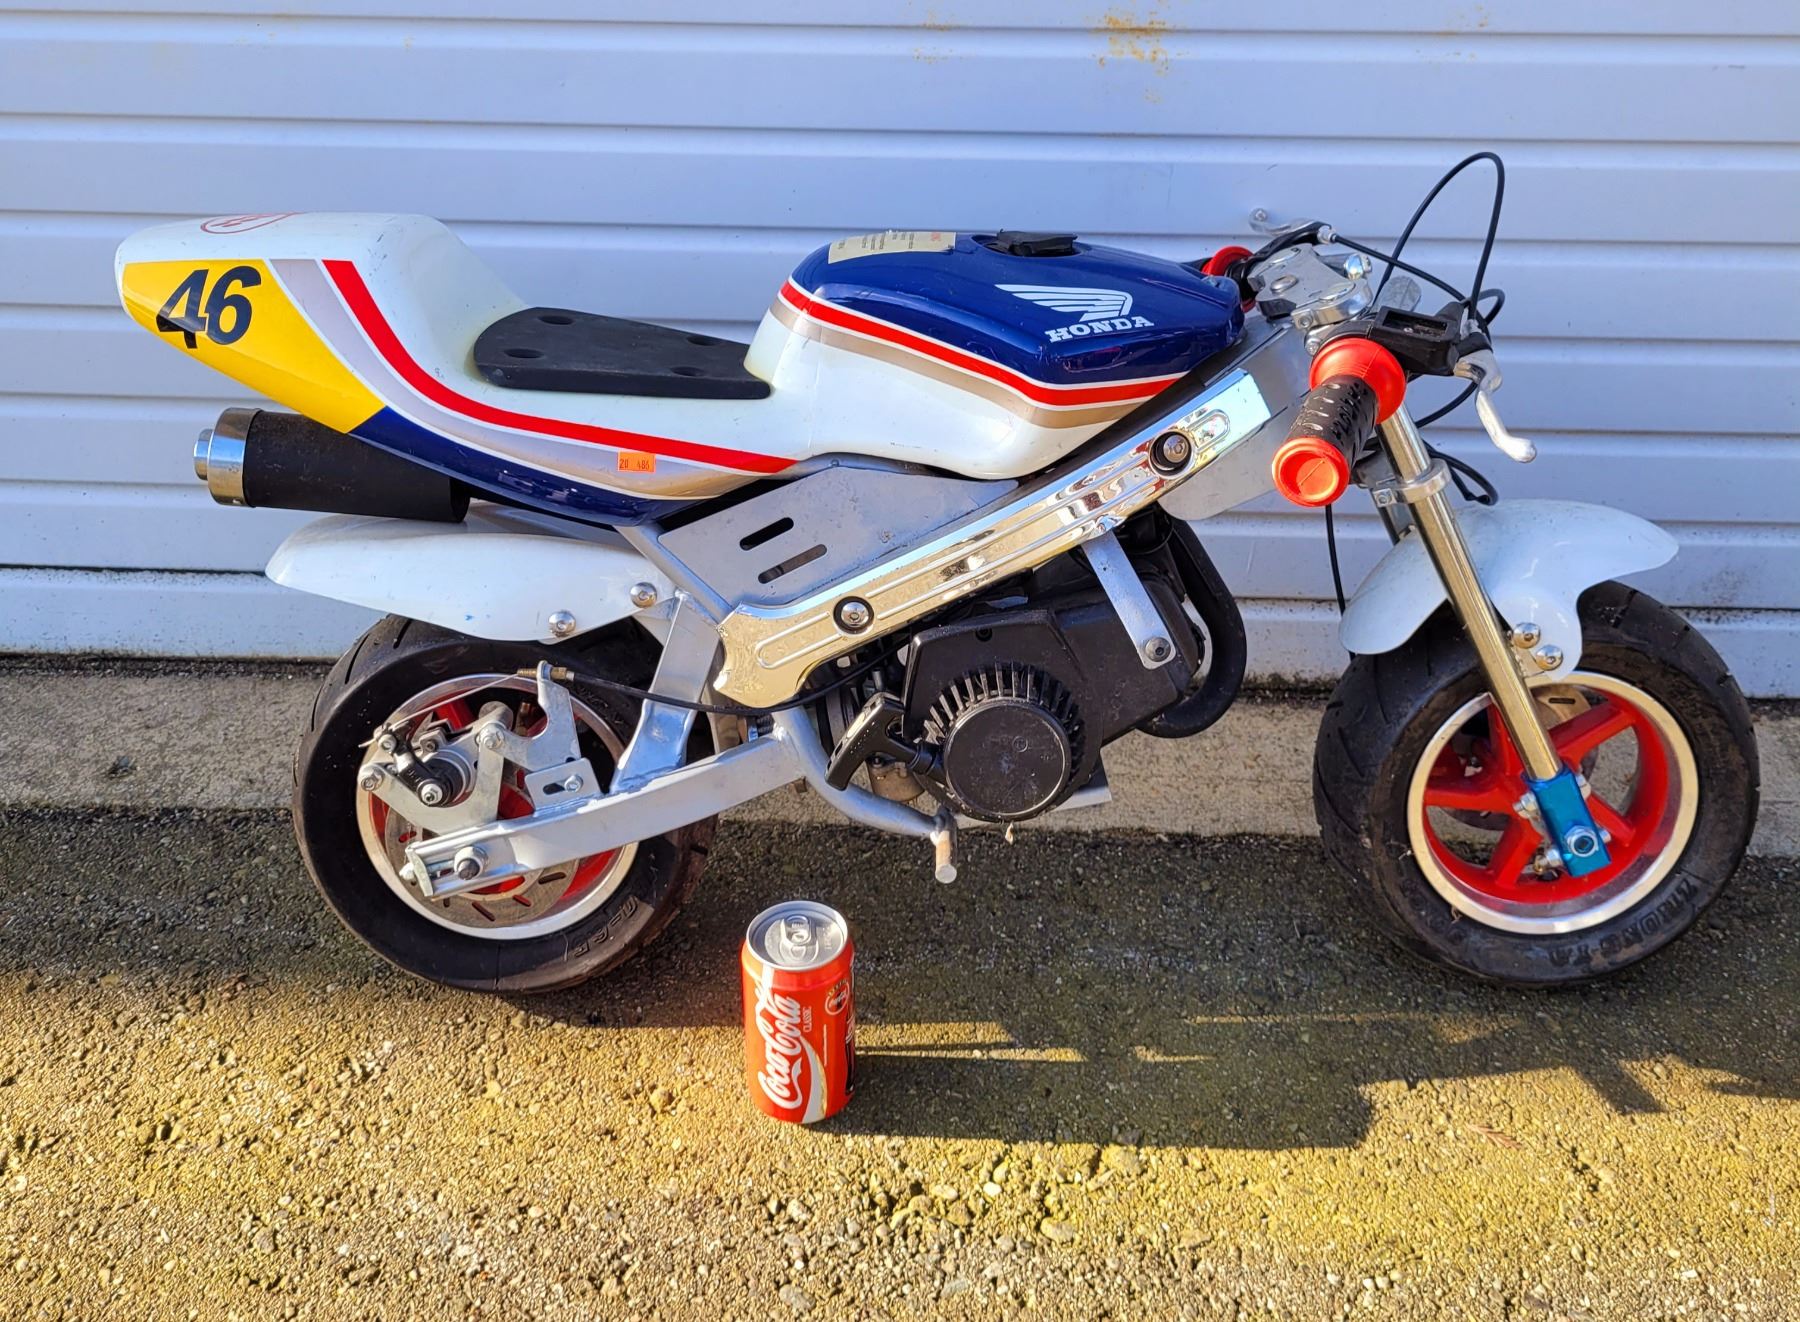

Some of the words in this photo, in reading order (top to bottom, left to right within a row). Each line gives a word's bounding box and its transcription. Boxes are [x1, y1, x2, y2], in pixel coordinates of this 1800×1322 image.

[157, 265, 262, 349] 46
[1045, 315, 1154, 343] HONDA
[803, 1006, 812, 1032] CLASSIC
